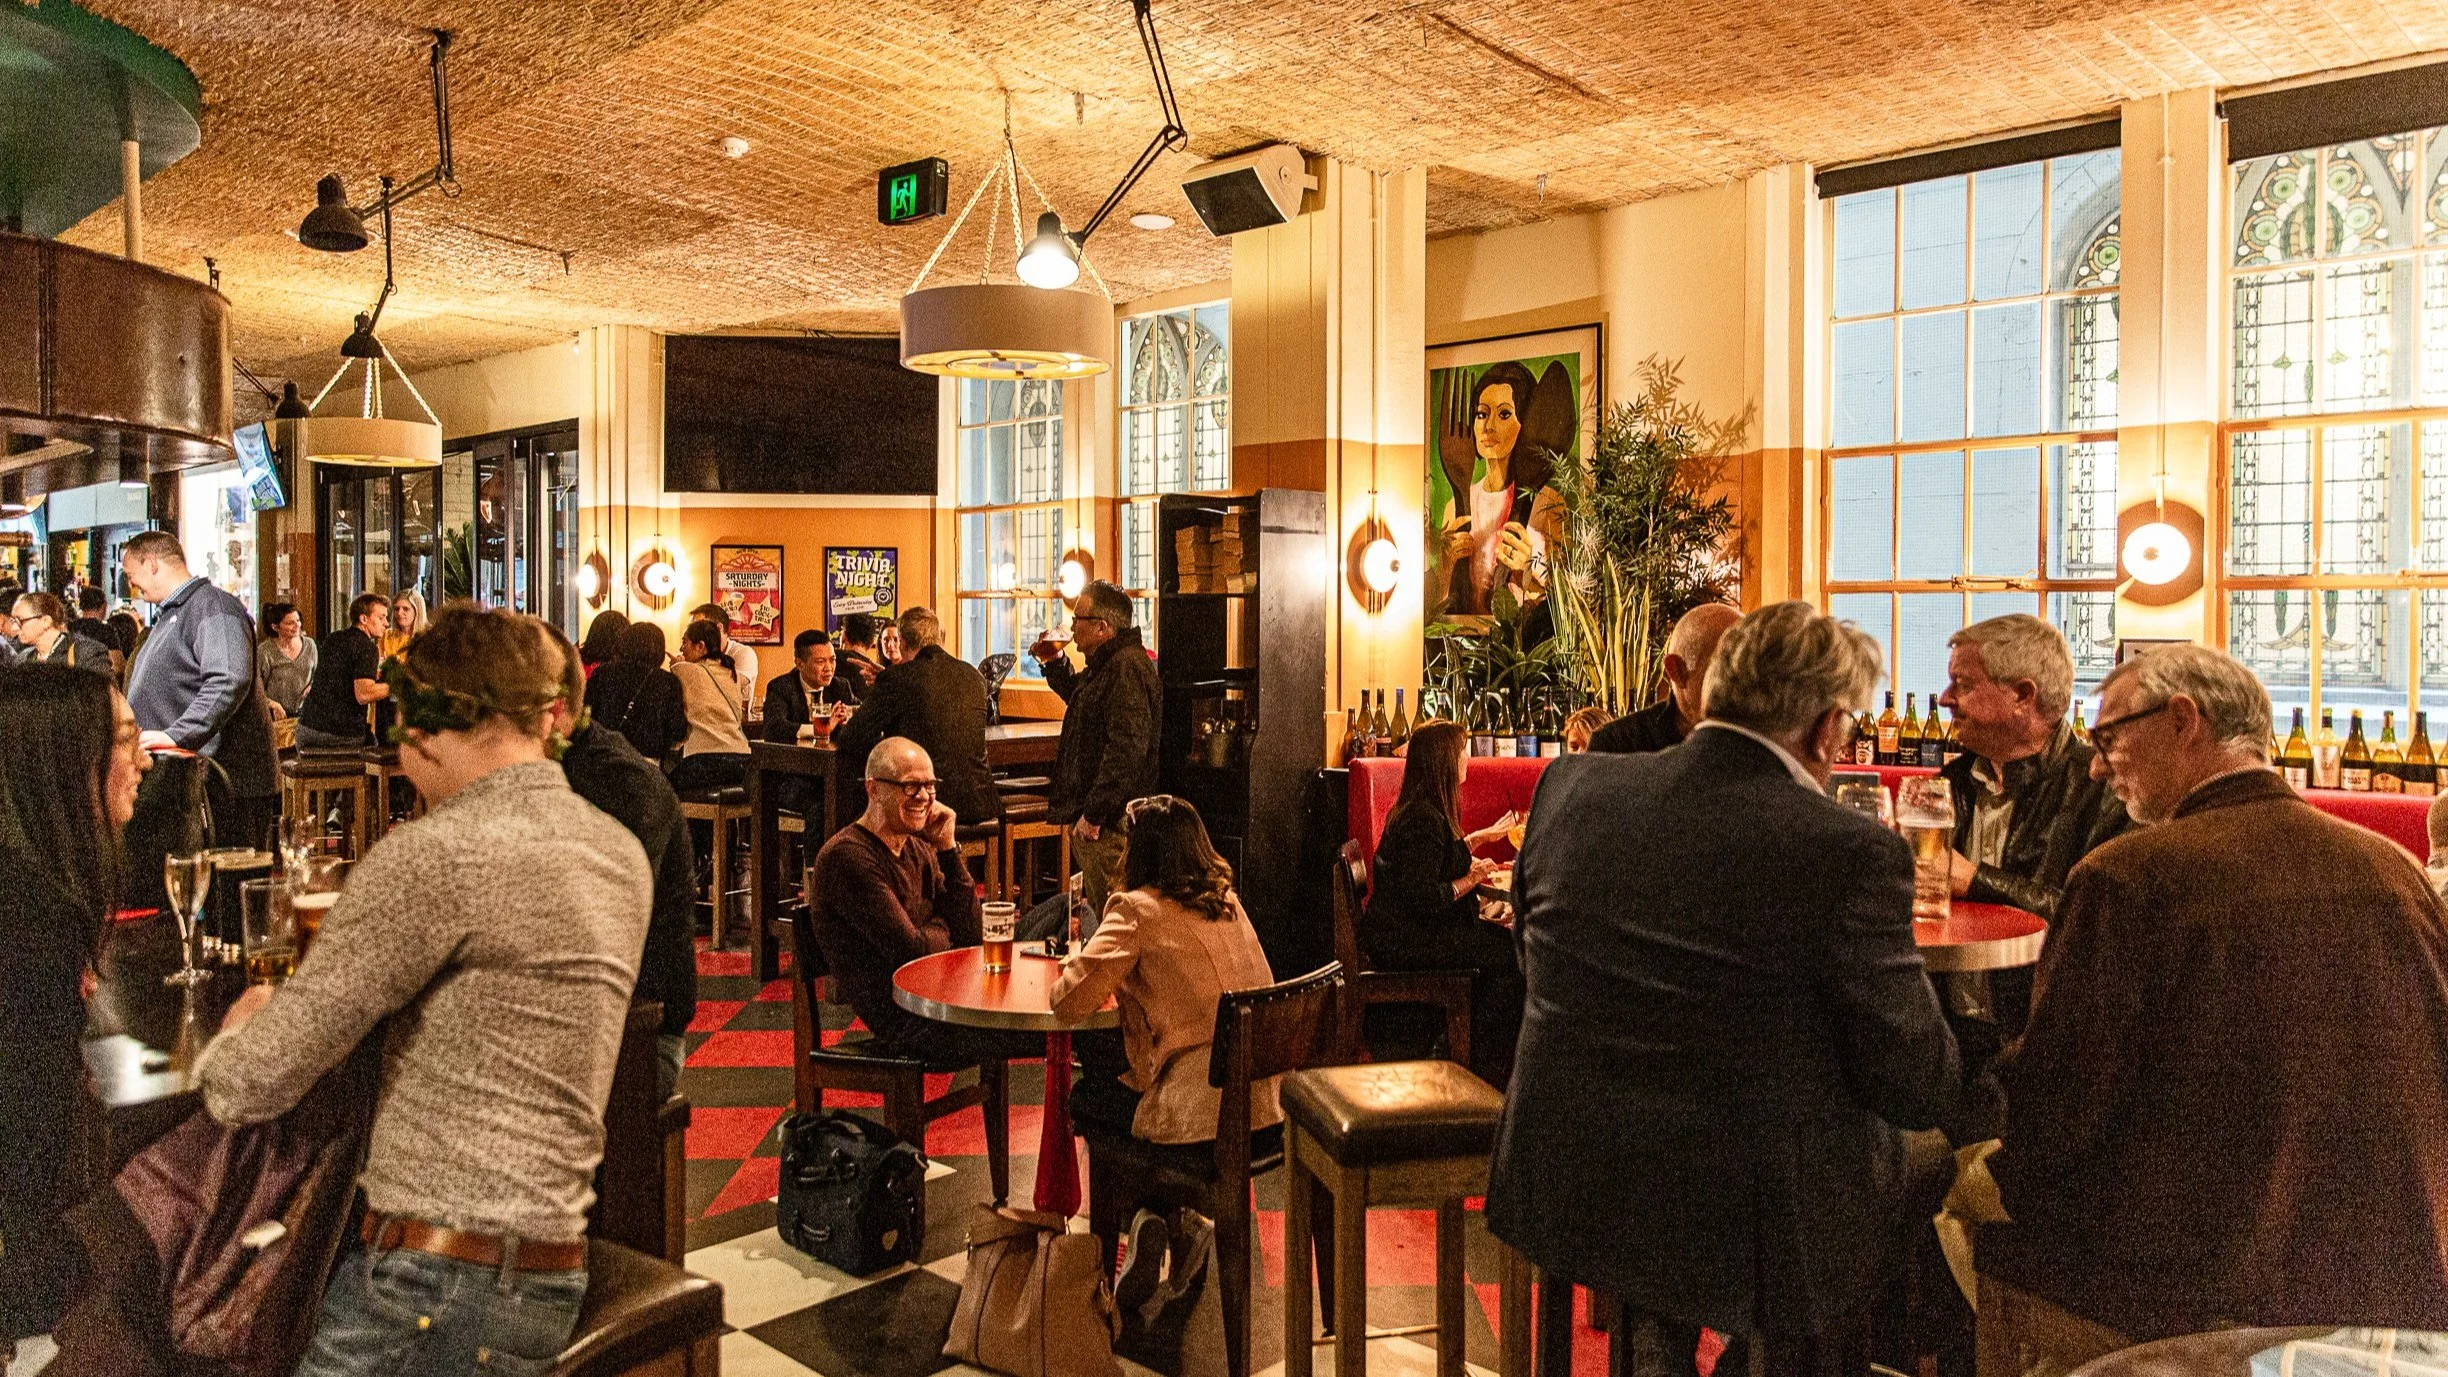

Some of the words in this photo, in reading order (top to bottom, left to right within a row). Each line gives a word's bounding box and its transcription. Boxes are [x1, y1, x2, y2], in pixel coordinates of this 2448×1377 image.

[836, 554, 891, 573] TRIVIA
[725, 572, 768, 581] SATURDAY
[836, 570, 888, 588] NIGHT
